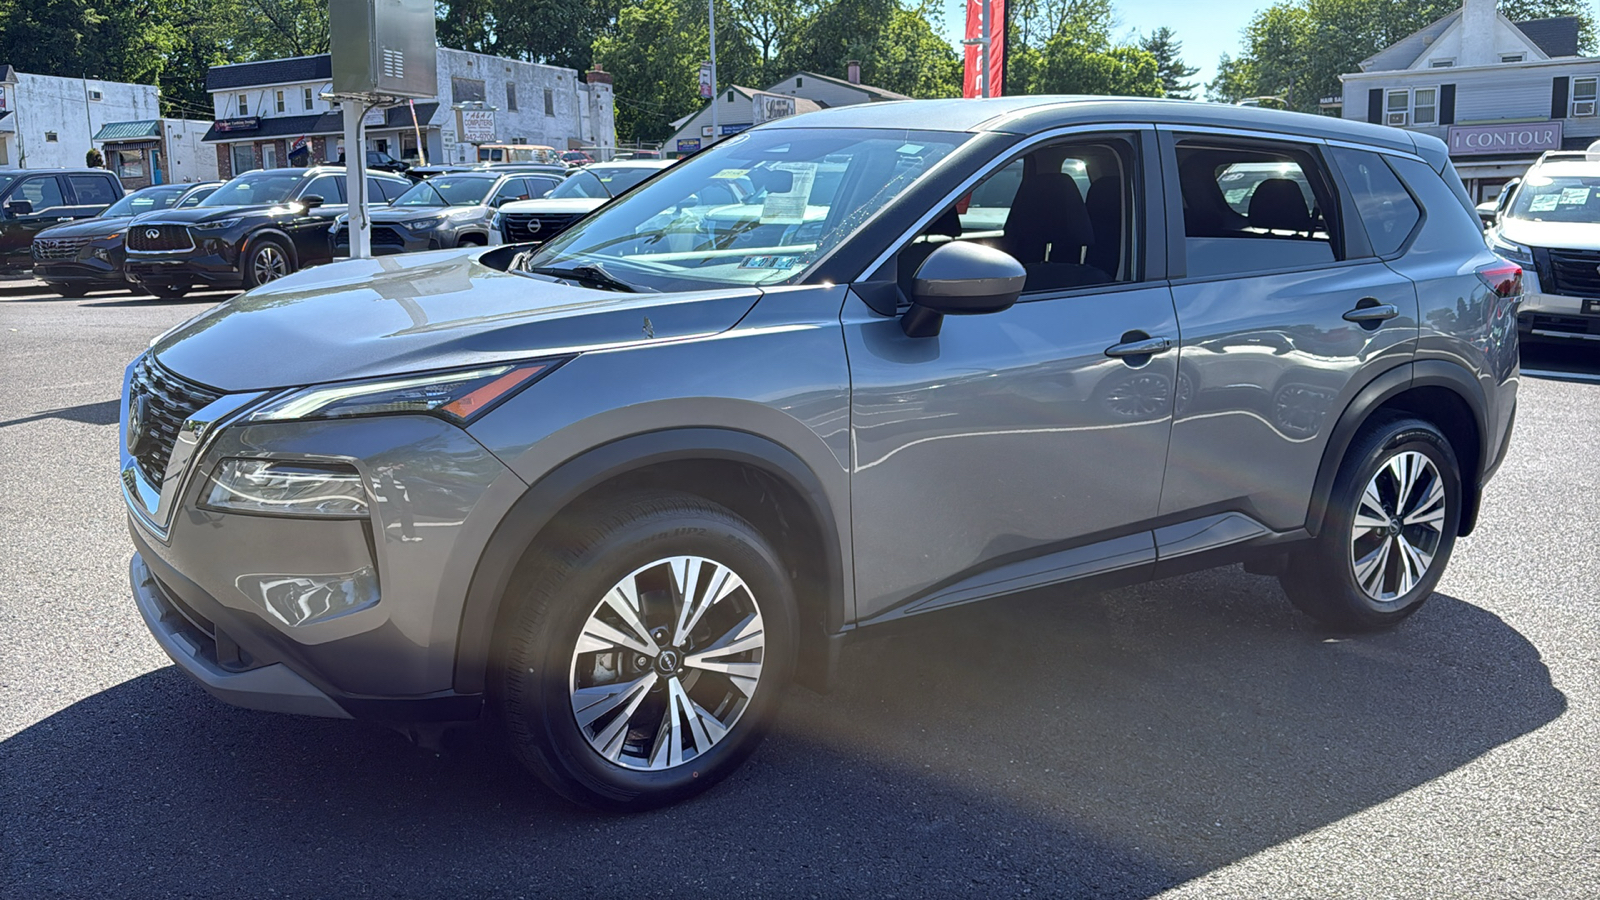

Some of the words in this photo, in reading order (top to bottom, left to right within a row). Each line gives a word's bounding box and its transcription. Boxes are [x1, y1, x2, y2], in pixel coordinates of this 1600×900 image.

[464, 119, 493, 127] COMPUTERS
[464, 133, 496, 141] 942-9700
[1465, 130, 1553, 148] CONTOUR
